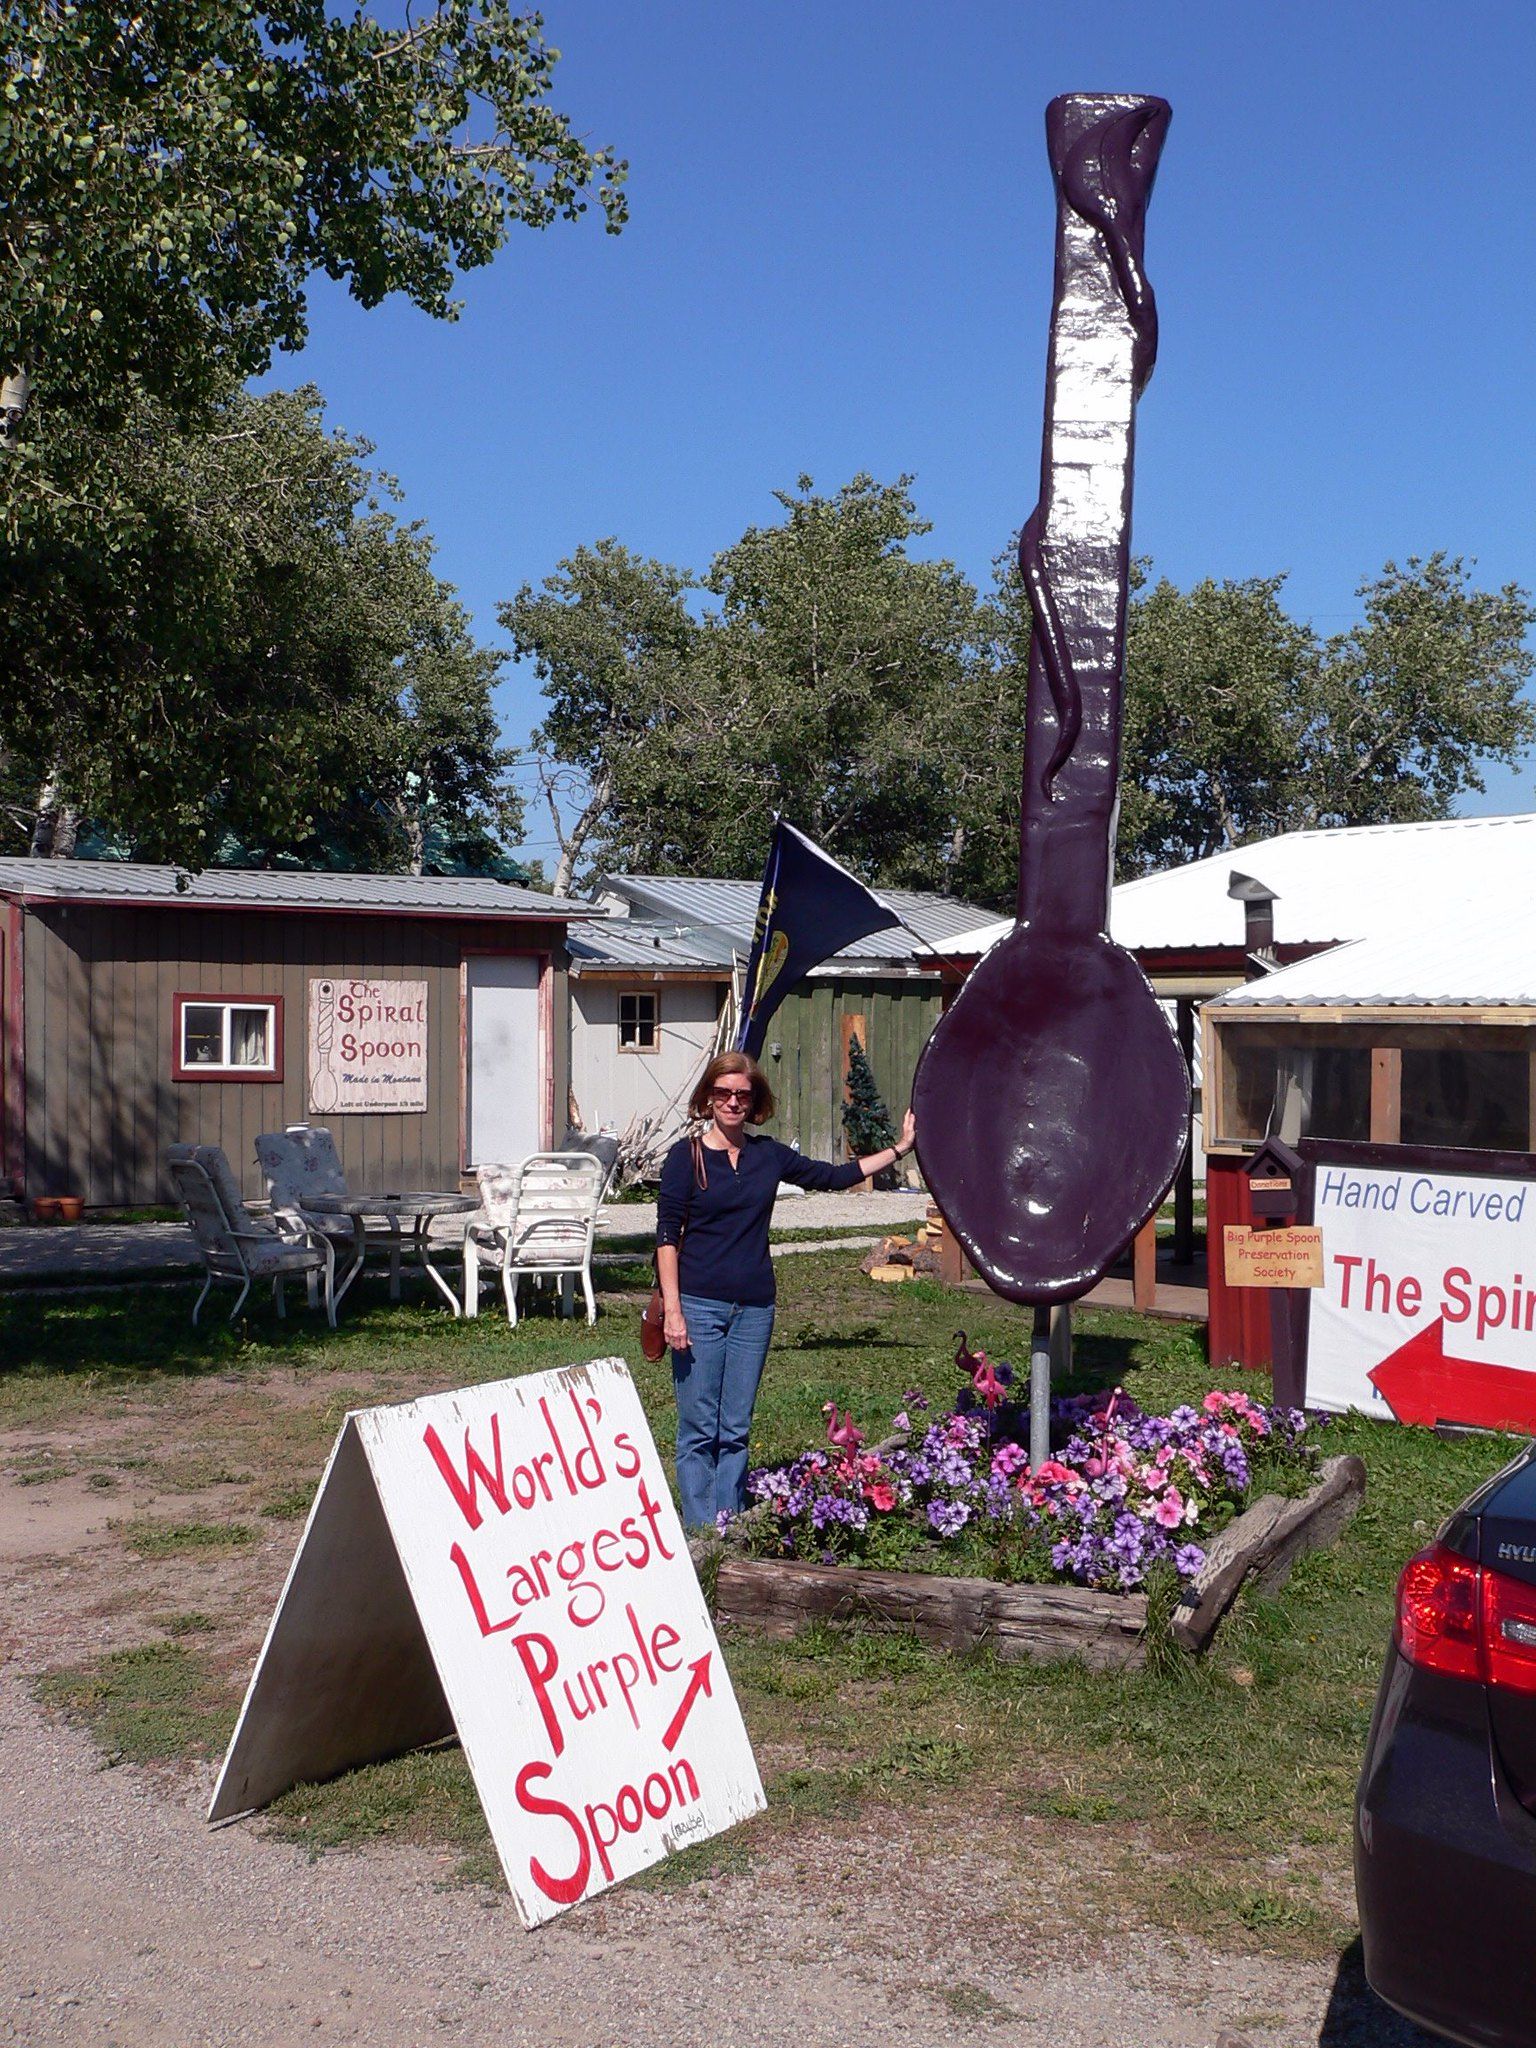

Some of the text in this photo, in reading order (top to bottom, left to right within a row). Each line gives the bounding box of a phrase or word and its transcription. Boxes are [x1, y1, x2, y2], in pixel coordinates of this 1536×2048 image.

[351, 981, 380, 998] The
[340, 1033, 421, 1066] Spoon
[342, 1073, 422, 1083] Made in Montana
[1250, 1181, 1288, 1190] Donations
[1321, 1171, 1527, 1222] Hand Carved
[1227, 1231, 1321, 1246] Big Purple Spoon
[1238, 1248, 1310, 1260] Preservation
[1253, 1266, 1296, 1280] Society
[1333, 1254, 1422, 1317] The
[423, 1388, 642, 1531] World's
[450, 1477, 675, 1637] Largest
[511, 1603, 683, 1757] Purple
[513, 1758, 701, 1904] Spoon
